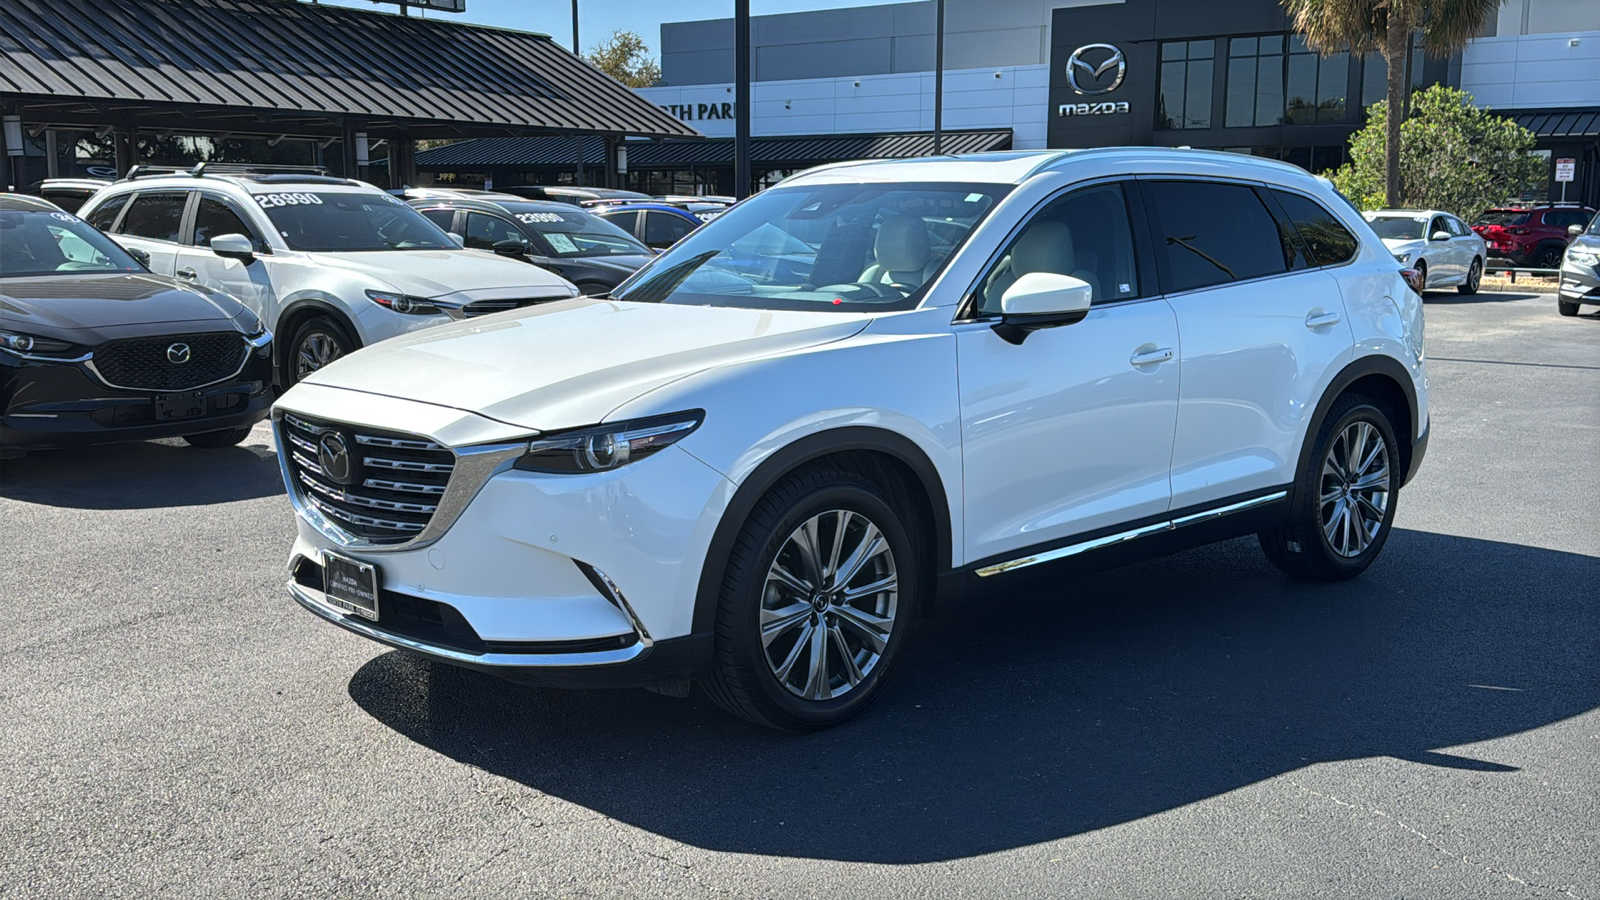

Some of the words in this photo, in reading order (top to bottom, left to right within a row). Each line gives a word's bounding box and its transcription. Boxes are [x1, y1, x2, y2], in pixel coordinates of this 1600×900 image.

[698, 103, 736, 120] PAR
[1059, 102, 1129, 116] mazda
[254, 193, 323, 208] 26990
